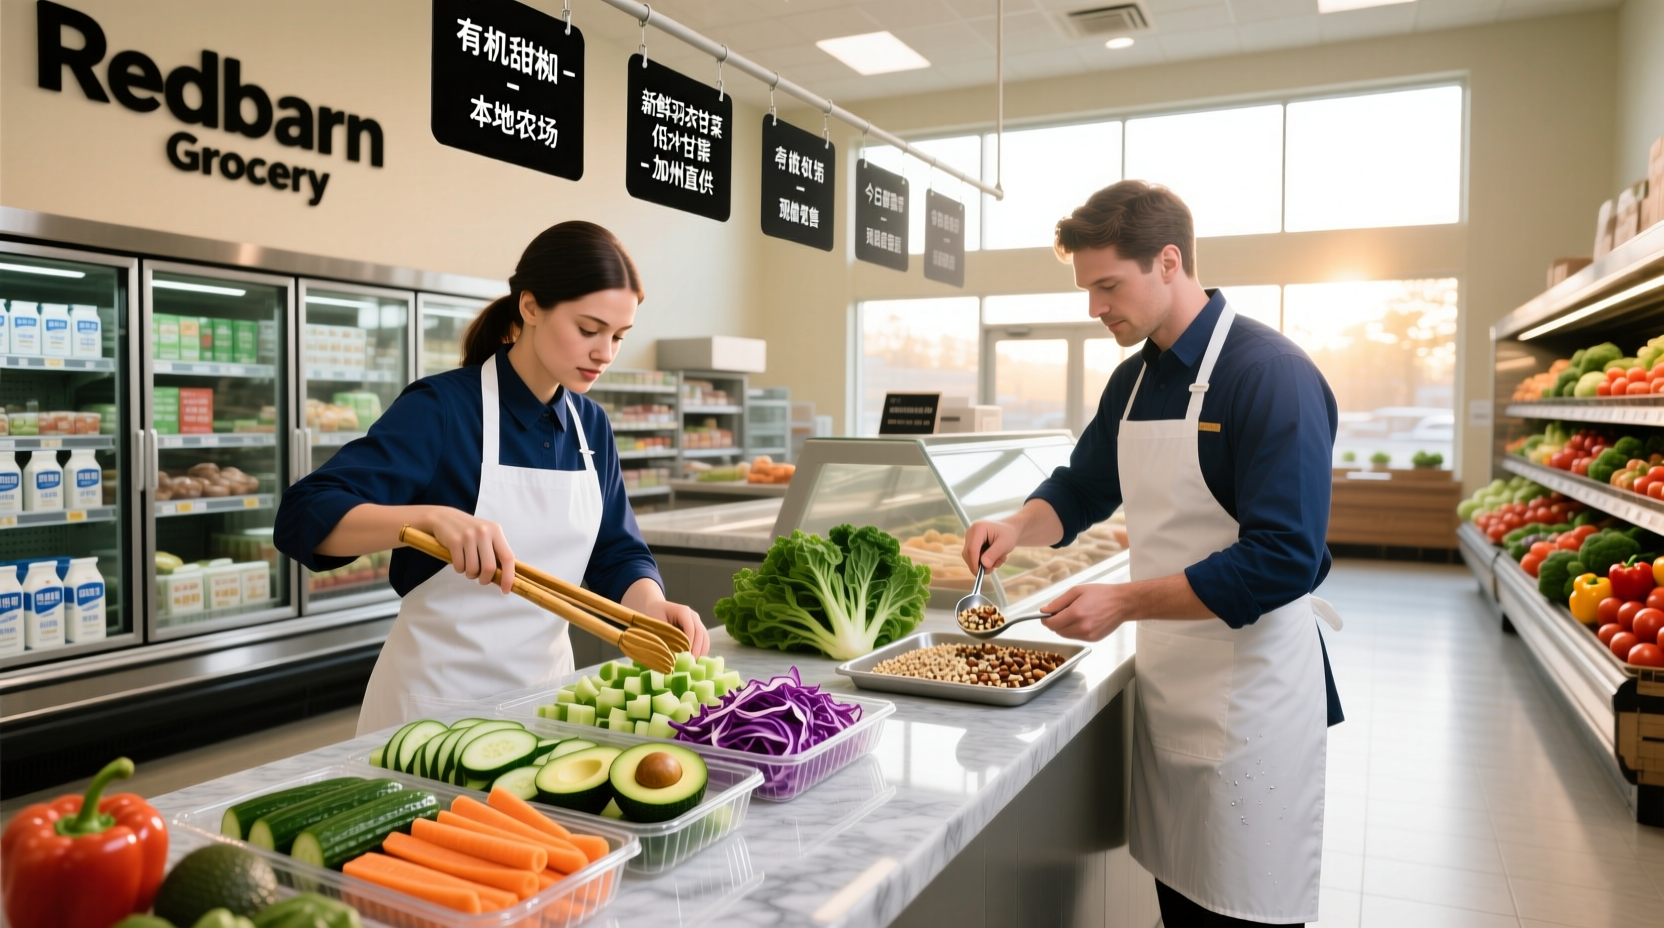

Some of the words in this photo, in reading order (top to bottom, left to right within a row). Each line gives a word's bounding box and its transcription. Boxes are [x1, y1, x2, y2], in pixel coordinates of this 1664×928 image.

[37, 0, 384, 168] Redbarn
[469, 94, 559, 149] 本地农场
[166, 131, 330, 207] Grocery
[651, 153, 714, 196] 加州直供
